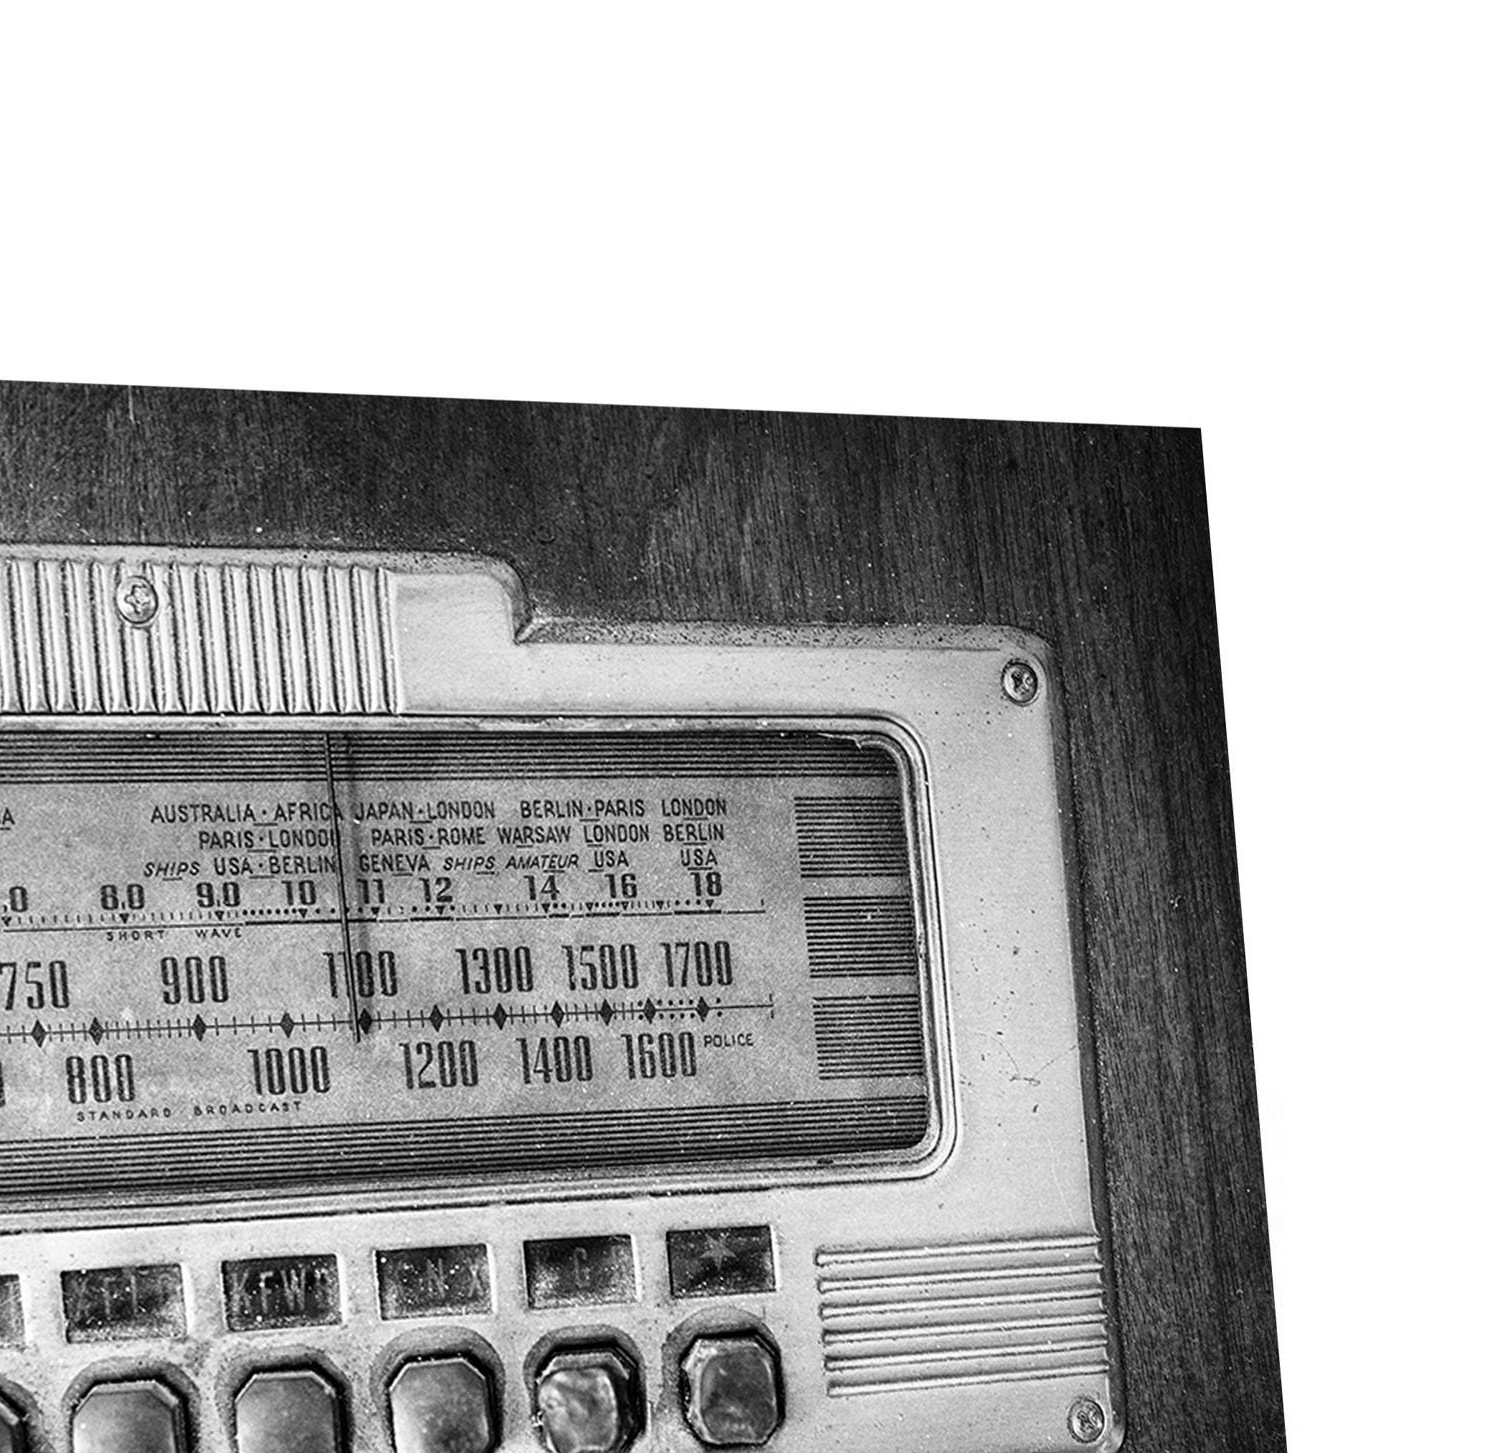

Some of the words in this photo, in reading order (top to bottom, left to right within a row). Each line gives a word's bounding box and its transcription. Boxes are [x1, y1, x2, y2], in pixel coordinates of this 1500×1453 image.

[151, 803, 256, 823] AUSTRALIA
[355, 801, 413, 821] JAPAN
[427, 800, 496, 820] LONDON
[520, 800, 583, 818] BERLIN
[595, 799, 645, 818] PARIS
[661, 798, 727, 817] LONDON
[200, 829, 254, 850] PARIS
[371, 828, 424, 847] PARIS
[438, 827, 486, 846] ROME
[497, 825, 571, 845] WARSAW
[583, 824, 650, 843] LONDON
[663, 824, 725, 842] BERLIN
[143, 861, 200, 877] SHIPS
[214, 857, 254, 876] USA
[269, 855, 337, 874] BERLIN
[359, 854, 431, 873] GENEVA
[443, 856, 496, 871] SHIPS
[505, 854, 579, 870] AMATEUR
[594, 850, 630, 868] USA
[680, 849, 718, 867] USA
[196, 880, 240, 908] 9.0
[282, 879, 316, 905] 10
[357, 878, 385, 904] 11
[419, 876, 453, 903] 12
[523, 874, 560, 900] 14
[604, 873, 637, 899] 16
[691, 871, 723, 897] 18
[106, 929, 166, 941] SHORT
[195, 928, 242, 939] WAVE
[0, 960, 70, 1011] 750
[160, 955, 229, 1005] 900
[322, 950, 398, 999] 1100
[455, 946, 534, 994] 1300
[561, 943, 639, 991] 1500
[659, 940, 734, 988] 1700
[703, 1032, 754, 1048] POLICE
[65, 1053, 136, 1104] 800
[247, 1046, 331, 1096] 1000
[399, 1039, 479, 1090] 1200
[515, 1035, 593, 1084] 1400
[621, 1031, 697, 1080] 1600
[76, 1107, 172, 1122] STANDARD
[194, 1100, 302, 1117] BROADCAST
